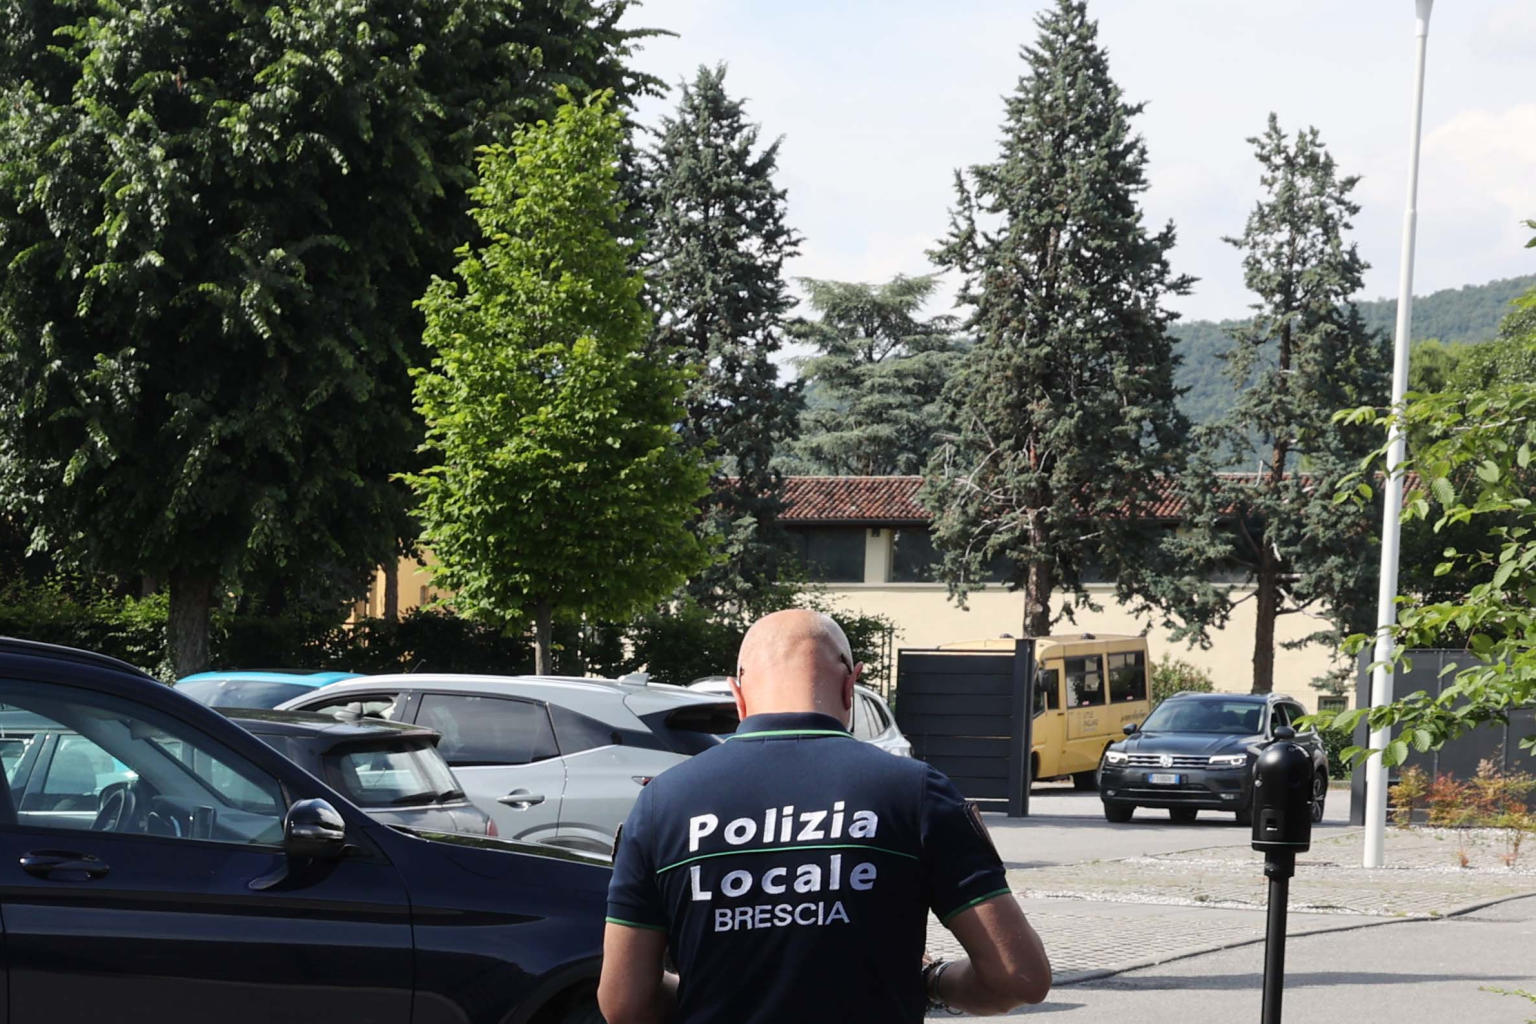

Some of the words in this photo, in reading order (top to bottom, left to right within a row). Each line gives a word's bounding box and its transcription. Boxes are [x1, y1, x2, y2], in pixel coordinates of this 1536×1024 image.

[688, 800, 879, 852] Polizia
[690, 854, 877, 901] Locale
[714, 901, 850, 932] BRESCIA
